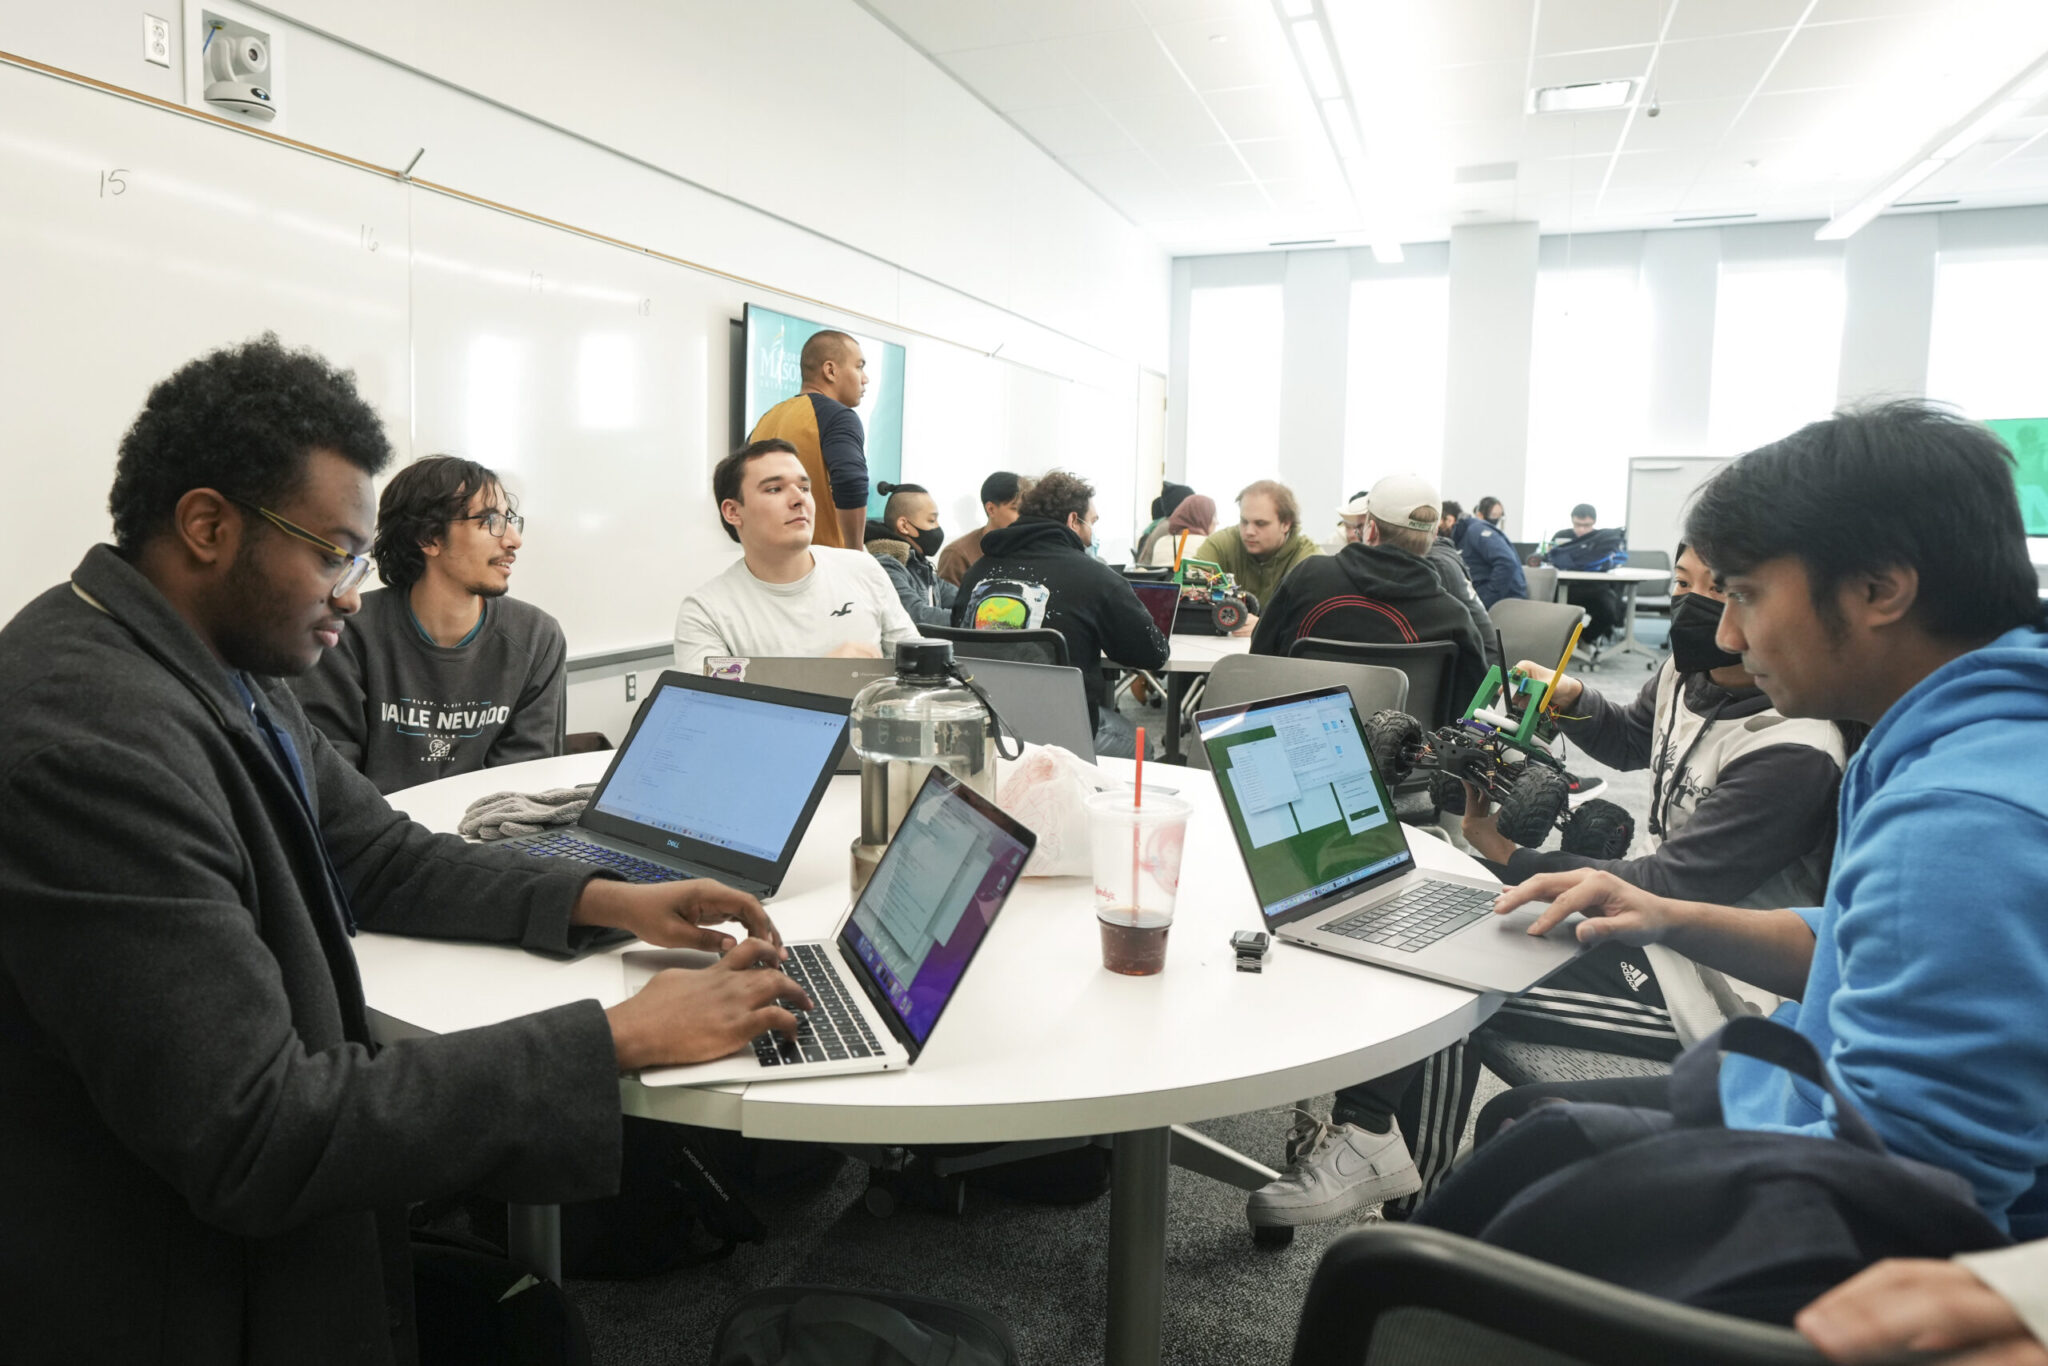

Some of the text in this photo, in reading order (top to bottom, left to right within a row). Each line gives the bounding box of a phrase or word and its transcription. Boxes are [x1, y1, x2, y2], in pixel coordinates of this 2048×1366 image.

[100, 168, 130, 198] 15
[360, 223, 380, 252] 16
[638, 298, 651, 317] 18
[381, 702, 510, 729] VALLE NEVADO
[666, 839, 681, 848] DELL
[1620, 961, 1640, 992] adidas
